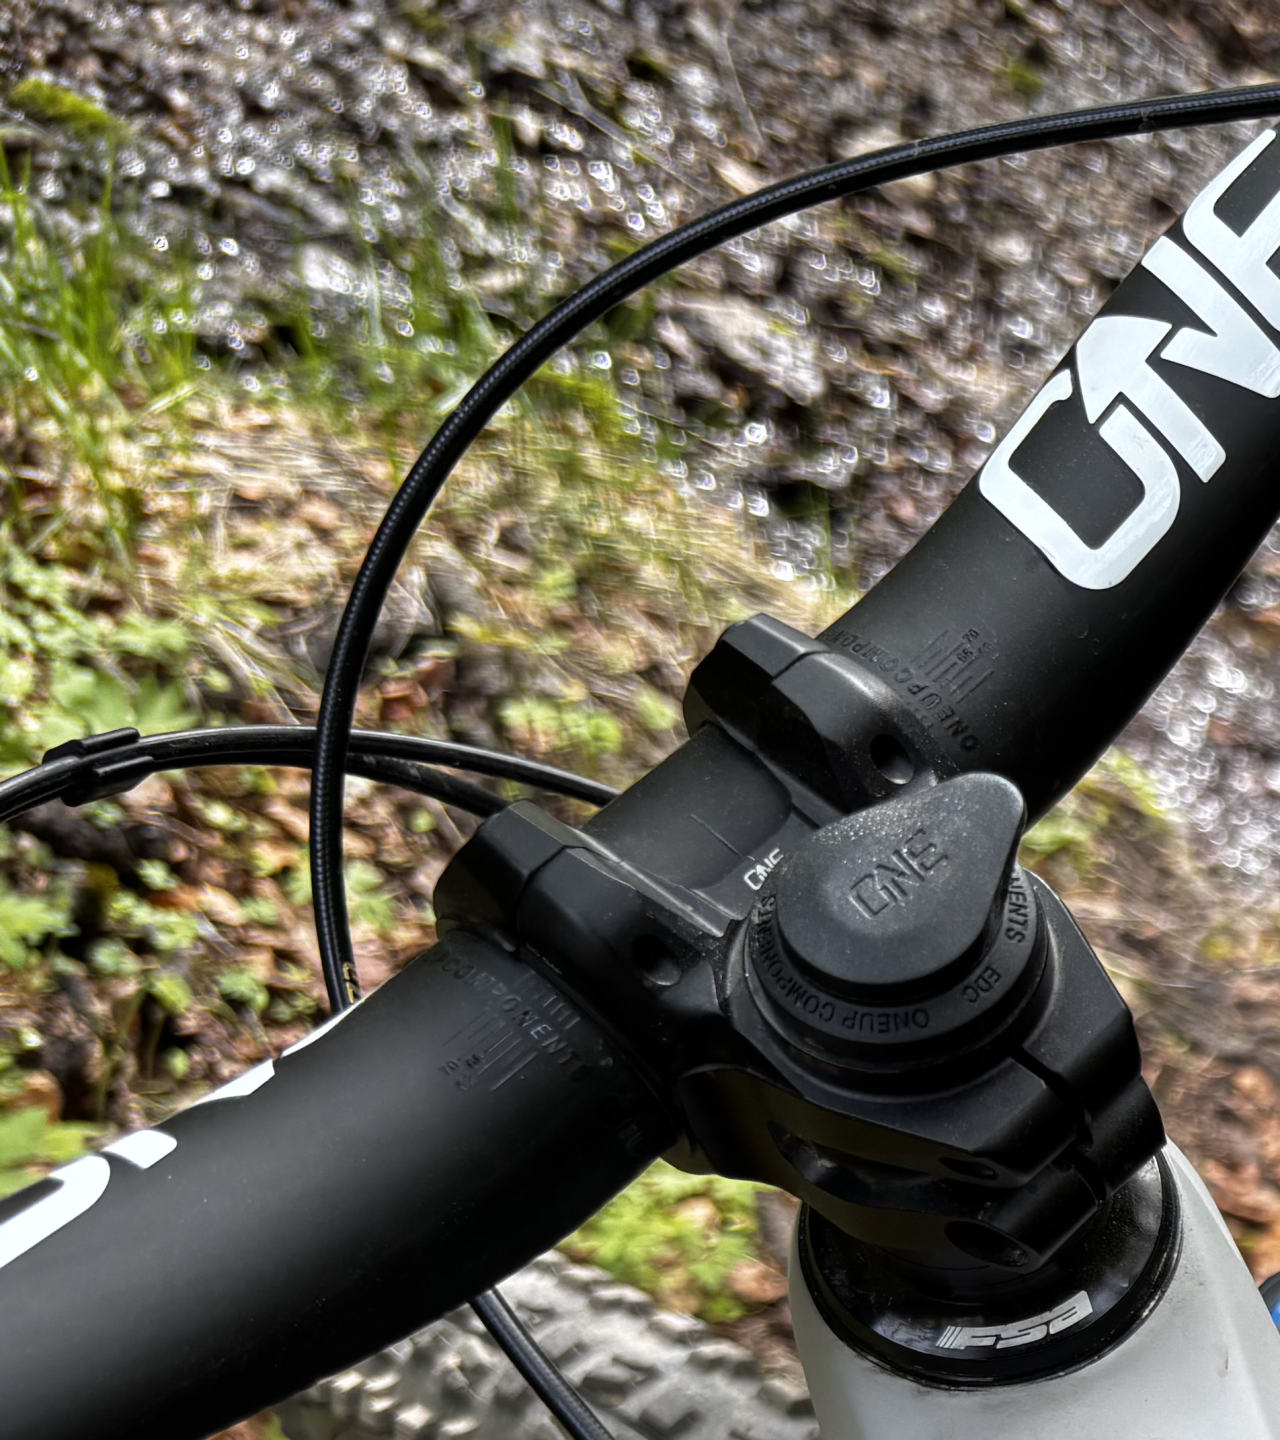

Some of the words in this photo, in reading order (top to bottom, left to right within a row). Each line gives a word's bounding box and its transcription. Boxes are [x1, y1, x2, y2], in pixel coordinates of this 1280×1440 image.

[850, 829, 949, 920] ONE
[962, 965, 1002, 1004] EDC
[841, 1006, 930, 1034] ONEUP
